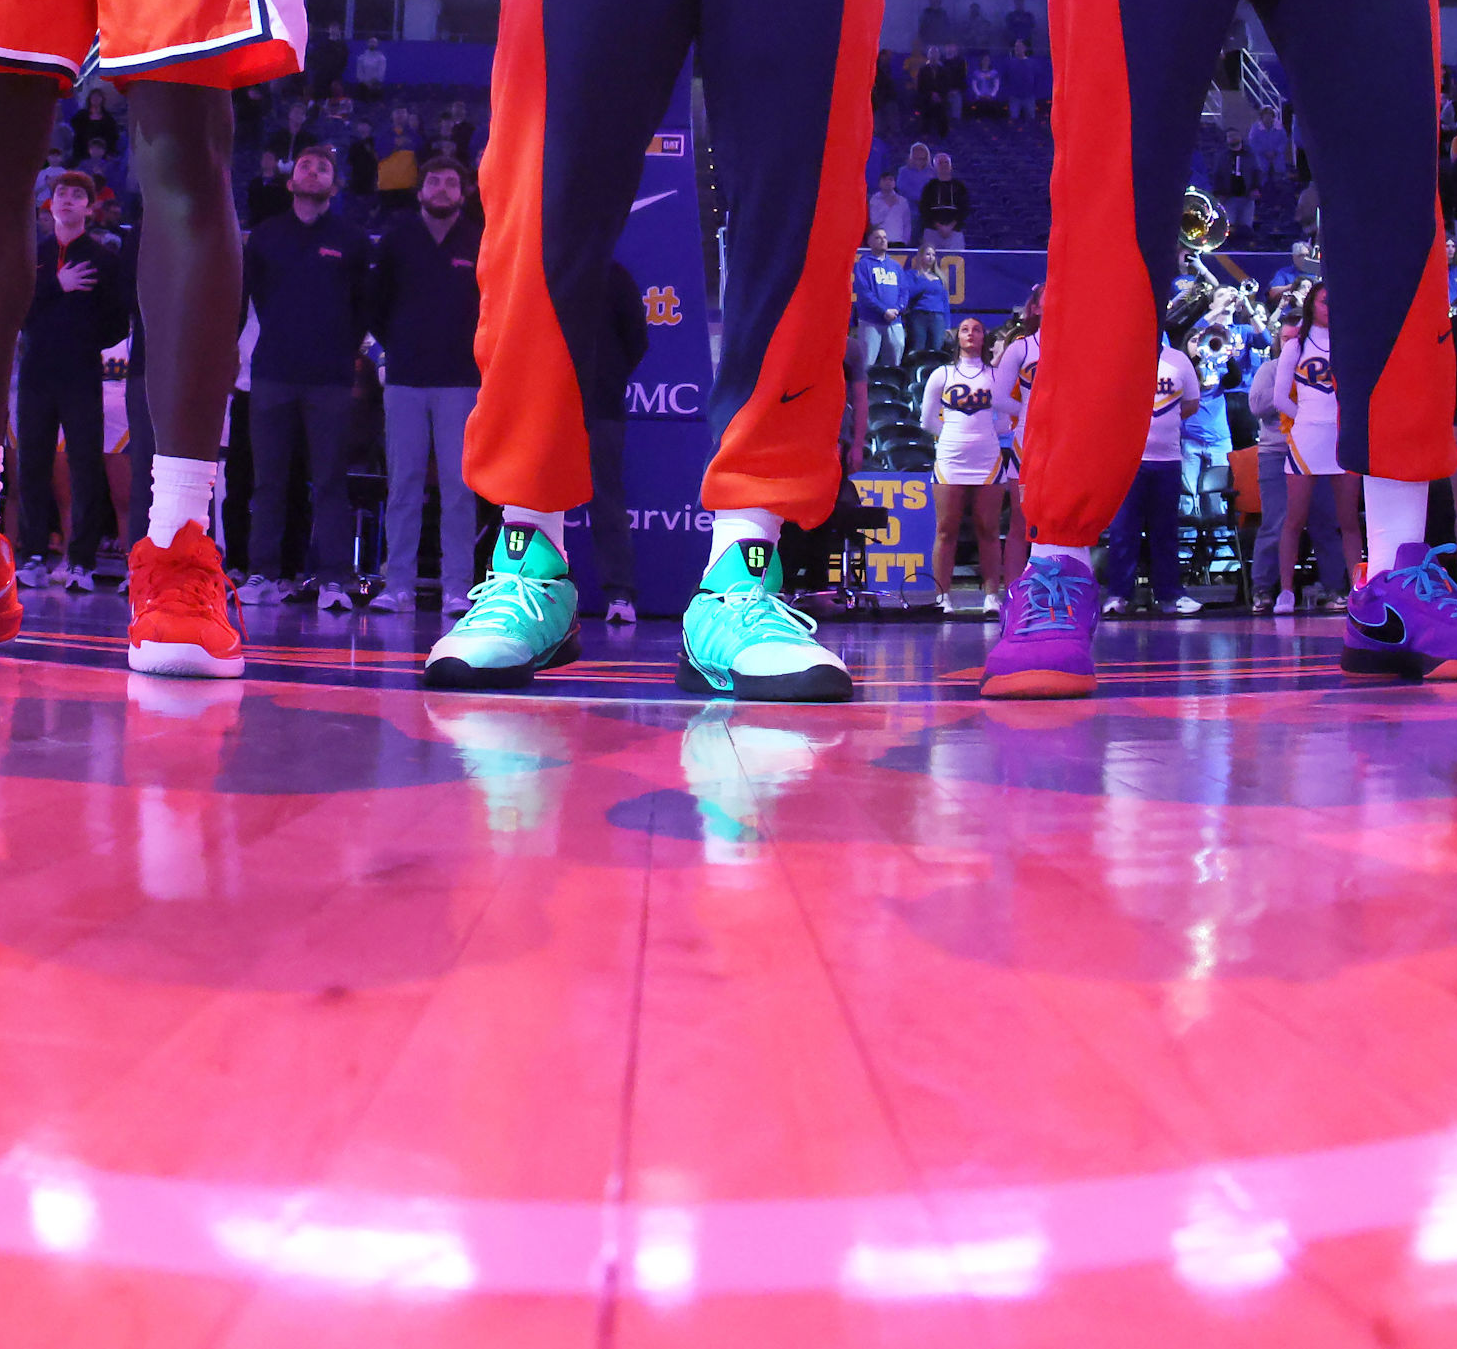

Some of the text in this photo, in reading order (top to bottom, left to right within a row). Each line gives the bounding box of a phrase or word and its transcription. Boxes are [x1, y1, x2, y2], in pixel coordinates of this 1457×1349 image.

[643, 285, 683, 326] tt
[944, 383, 992, 409] Pitt
[851, 480, 928, 510] ETS
